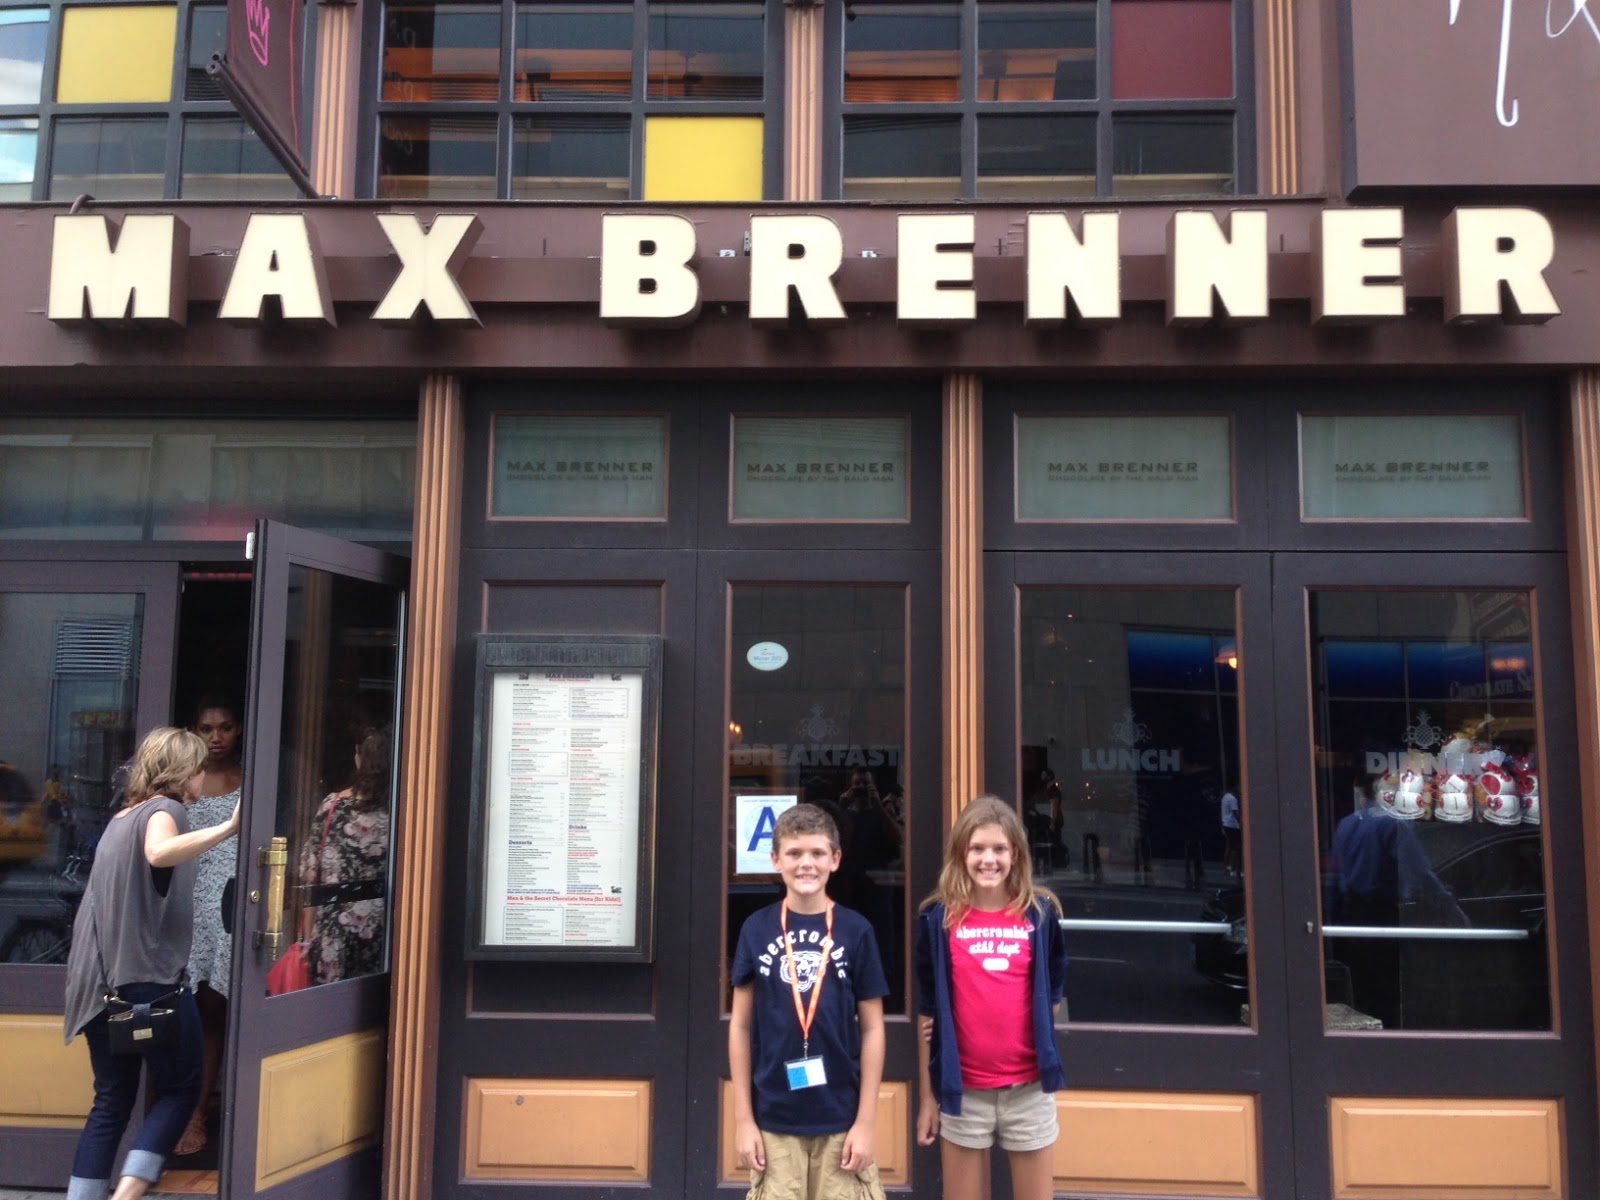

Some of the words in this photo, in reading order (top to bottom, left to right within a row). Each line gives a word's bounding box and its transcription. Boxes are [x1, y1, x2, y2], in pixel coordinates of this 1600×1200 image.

[48, 212, 478, 320] MAX
[600, 207, 1562, 320] BRENNER
[507, 461, 546, 472] MAX
[556, 461, 654, 472] BRENNER
[747, 463, 787, 473] MAX
[796, 462, 894, 473] BRENNER
[1048, 462, 1088, 472] MAX
[1098, 462, 1199, 473] BRENNER
[1335, 462, 1376, 472] MAX
[1386, 461, 1489, 473] BRENNER
[731, 743, 900, 766] BREAKFAST
[1081, 748, 1181, 771] LUNCH
[747, 806, 777, 852] A
[956, 925, 1029, 940] abercrombie
[758, 929, 849, 979] abercrombie
